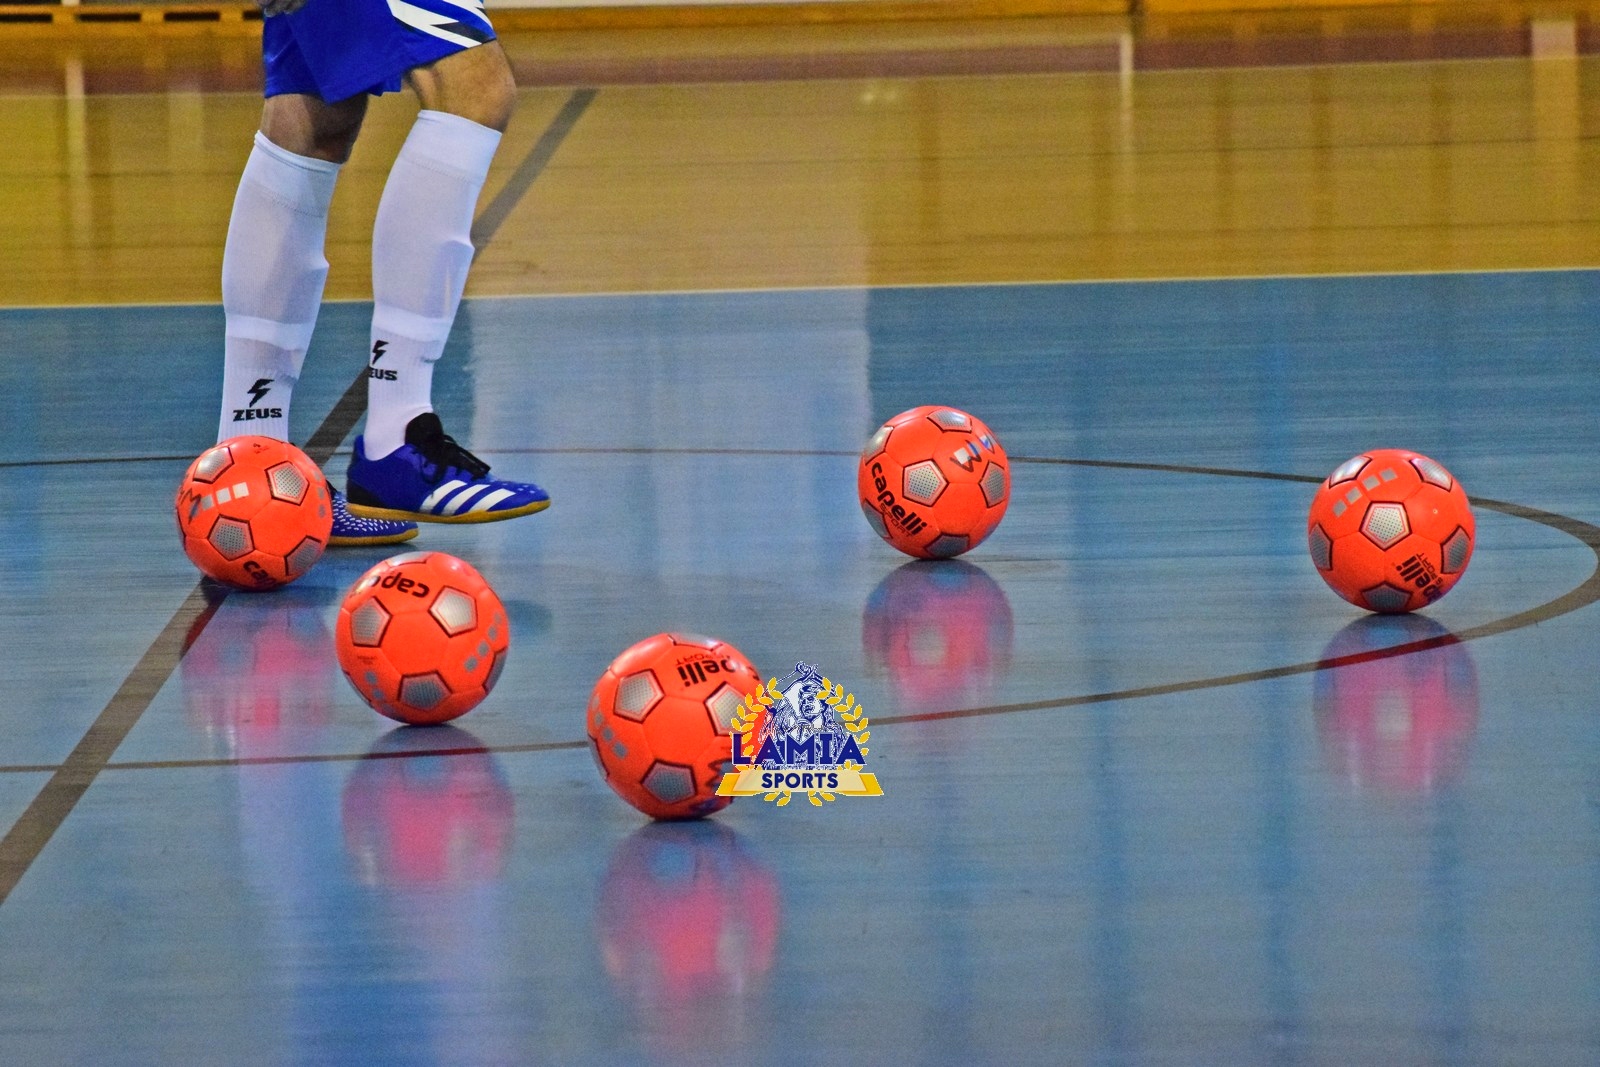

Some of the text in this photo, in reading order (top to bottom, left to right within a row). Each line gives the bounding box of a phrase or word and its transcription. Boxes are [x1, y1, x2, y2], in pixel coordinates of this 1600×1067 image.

[233, 407, 282, 422] ZEUS
[871, 461, 928, 536] capelli
[371, 571, 430, 598] cap
